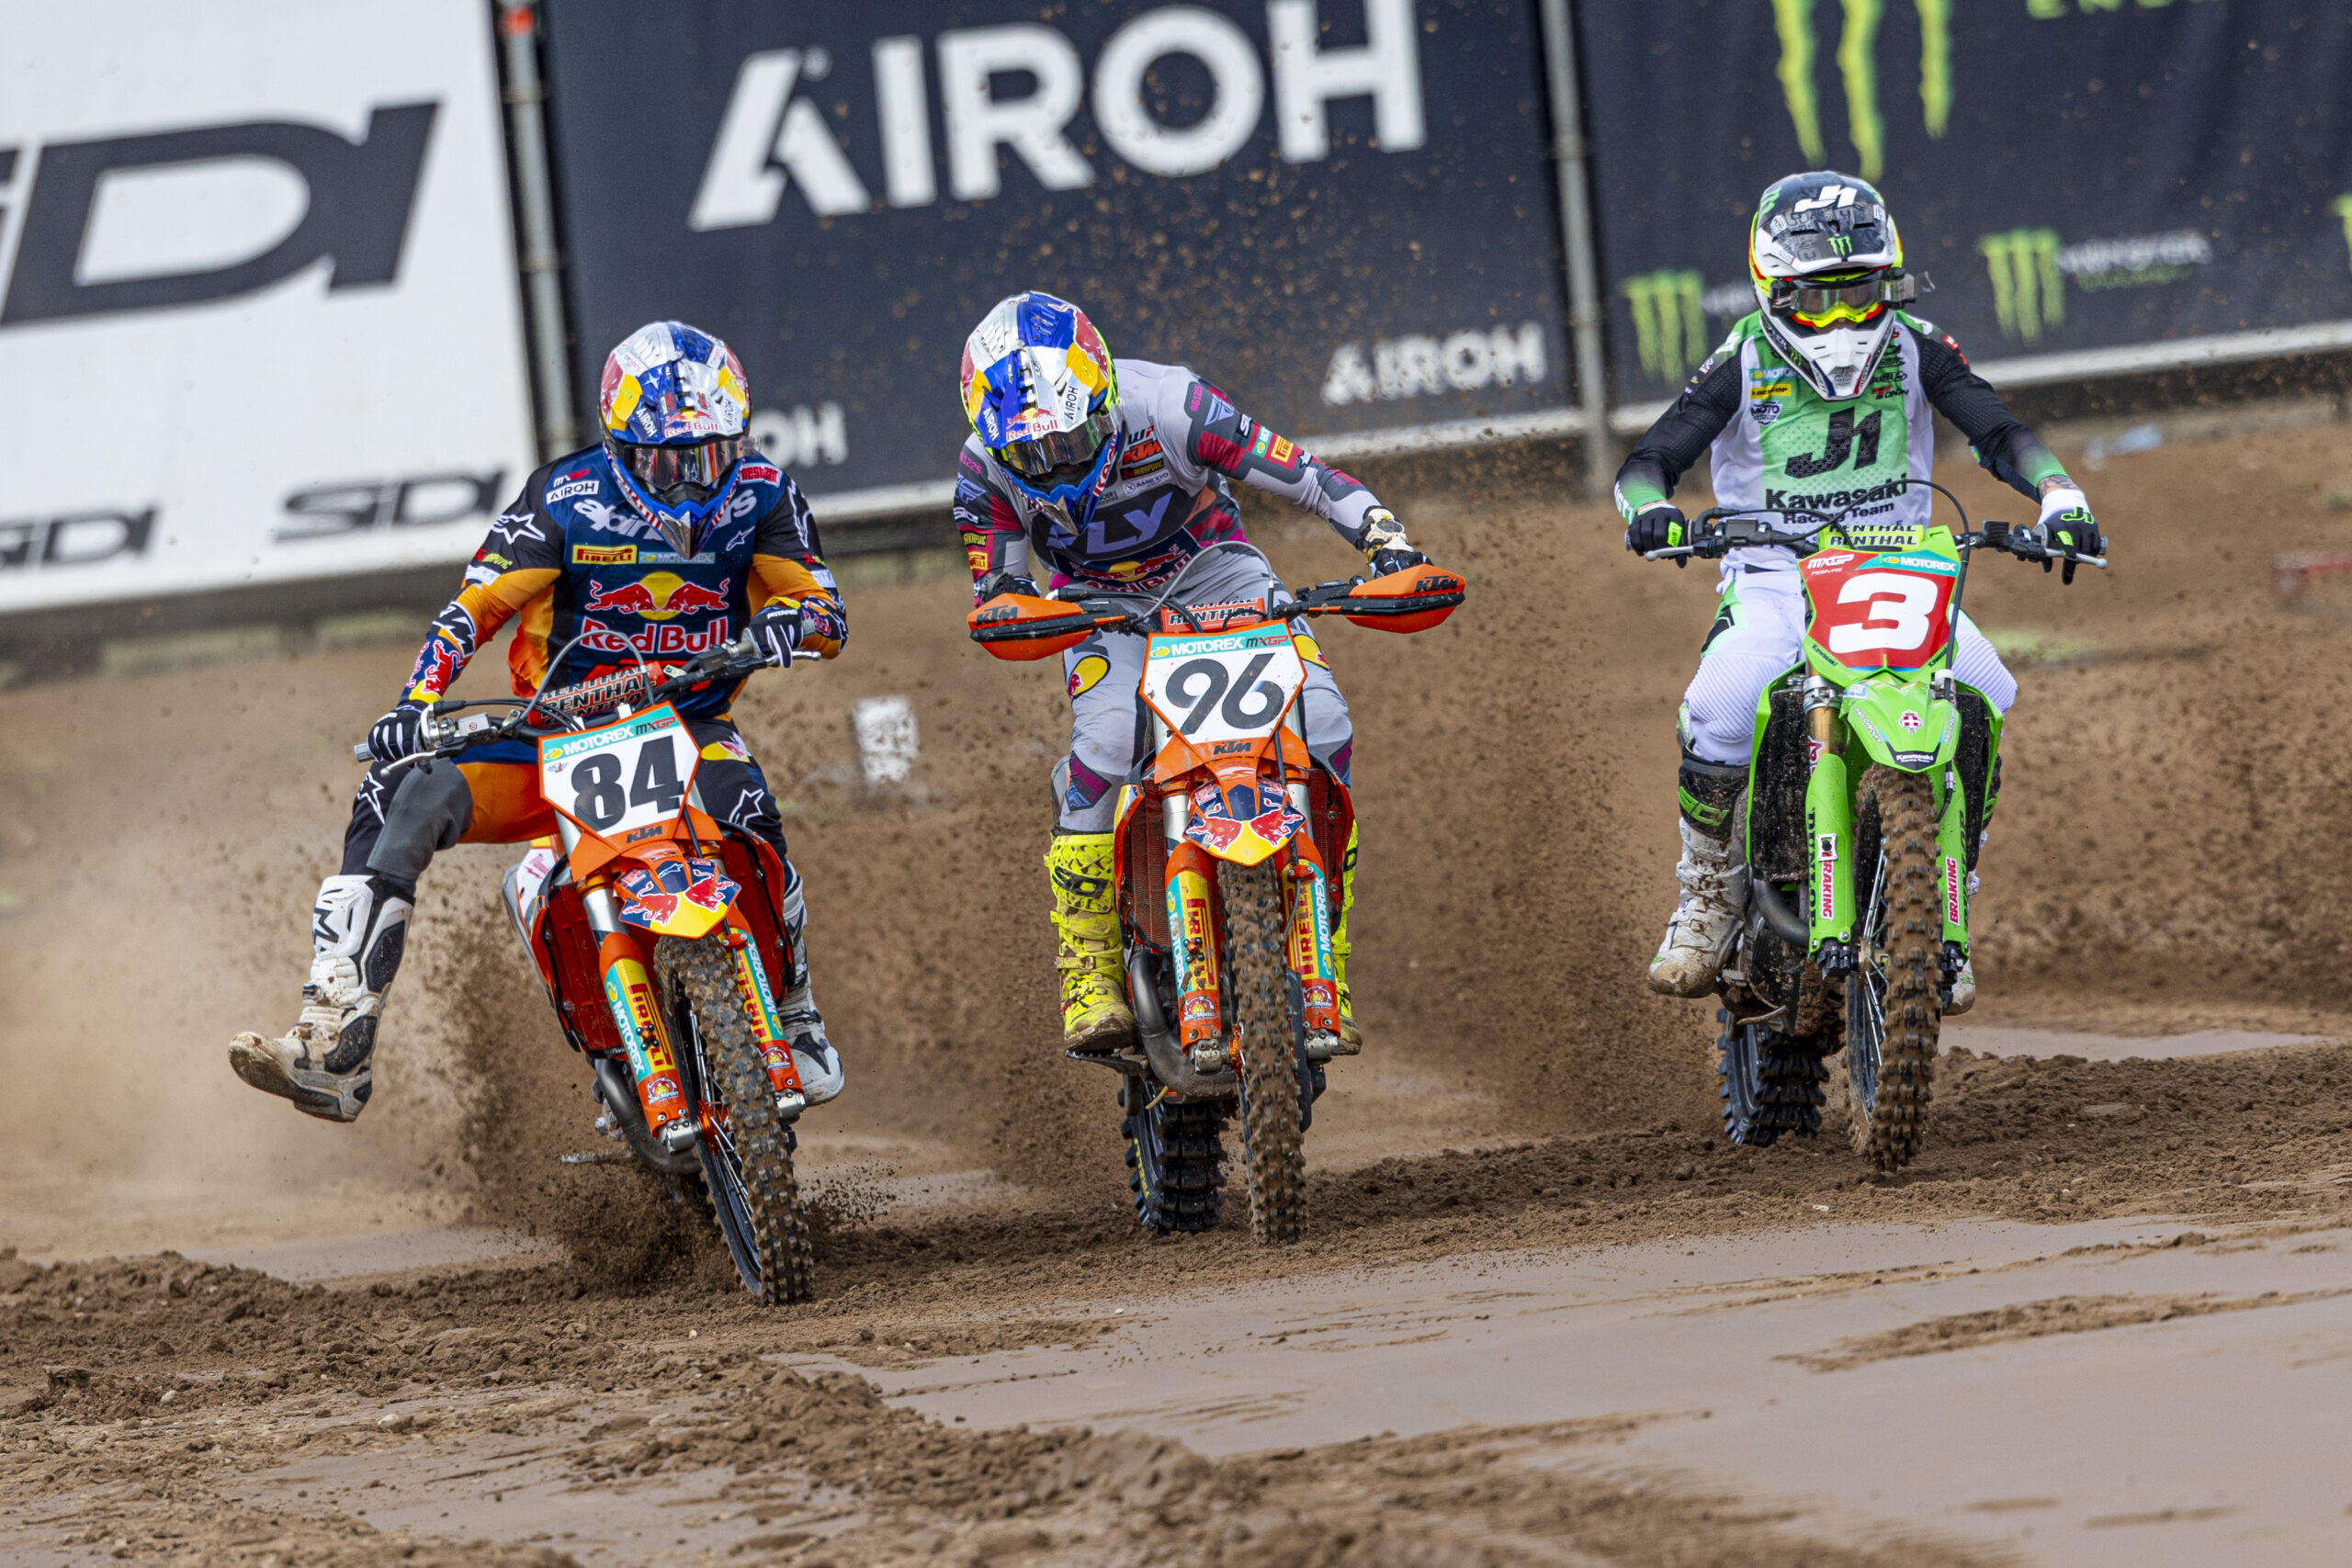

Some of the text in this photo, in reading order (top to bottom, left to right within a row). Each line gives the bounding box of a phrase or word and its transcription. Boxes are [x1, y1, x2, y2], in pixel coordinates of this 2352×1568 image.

[688, 0, 1427, 233] AIROH
[1320, 321, 1547, 405] AIROH
[1064, 386, 1079, 420] AIROH
[636, 408, 658, 437] AIROH
[665, 423, 718, 437] Red Bull
[982, 407, 1000, 441] AIROH
[1006, 419, 1058, 441] Red Bull
[1123, 440, 1162, 465] KTM
[551, 483, 595, 501] AIROH
[1765, 473, 1908, 511] Kawasaki
[1850, 502, 1894, 518] Team
[577, 548, 633, 561] PIRELLI
[1806, 554, 1855, 570] MXGP
[1900, 557, 1956, 572] MOTOREX
[976, 604, 1018, 626] KTM
[1828, 572, 1939, 654] 3
[581, 616, 728, 653] Red Bull
[1171, 637, 1244, 656] MOTOREX
[1246, 635, 1288, 648] MXGP
[1812, 644, 1838, 669] Kawasaki
[1166, 652, 1284, 736] 96
[636, 716, 675, 736] MXGP
[563, 725, 634, 756] MOTOREX
[1213, 740, 1251, 755] KTM
[571, 735, 685, 832] 84
[627, 825, 662, 843] KTM
[1946, 857, 1960, 923] BRAKING
[1316, 877, 1331, 953] MOTOREX
[748, 942, 776, 1013] MOTOREX
[613, 1002, 644, 1076] MOTOREX
